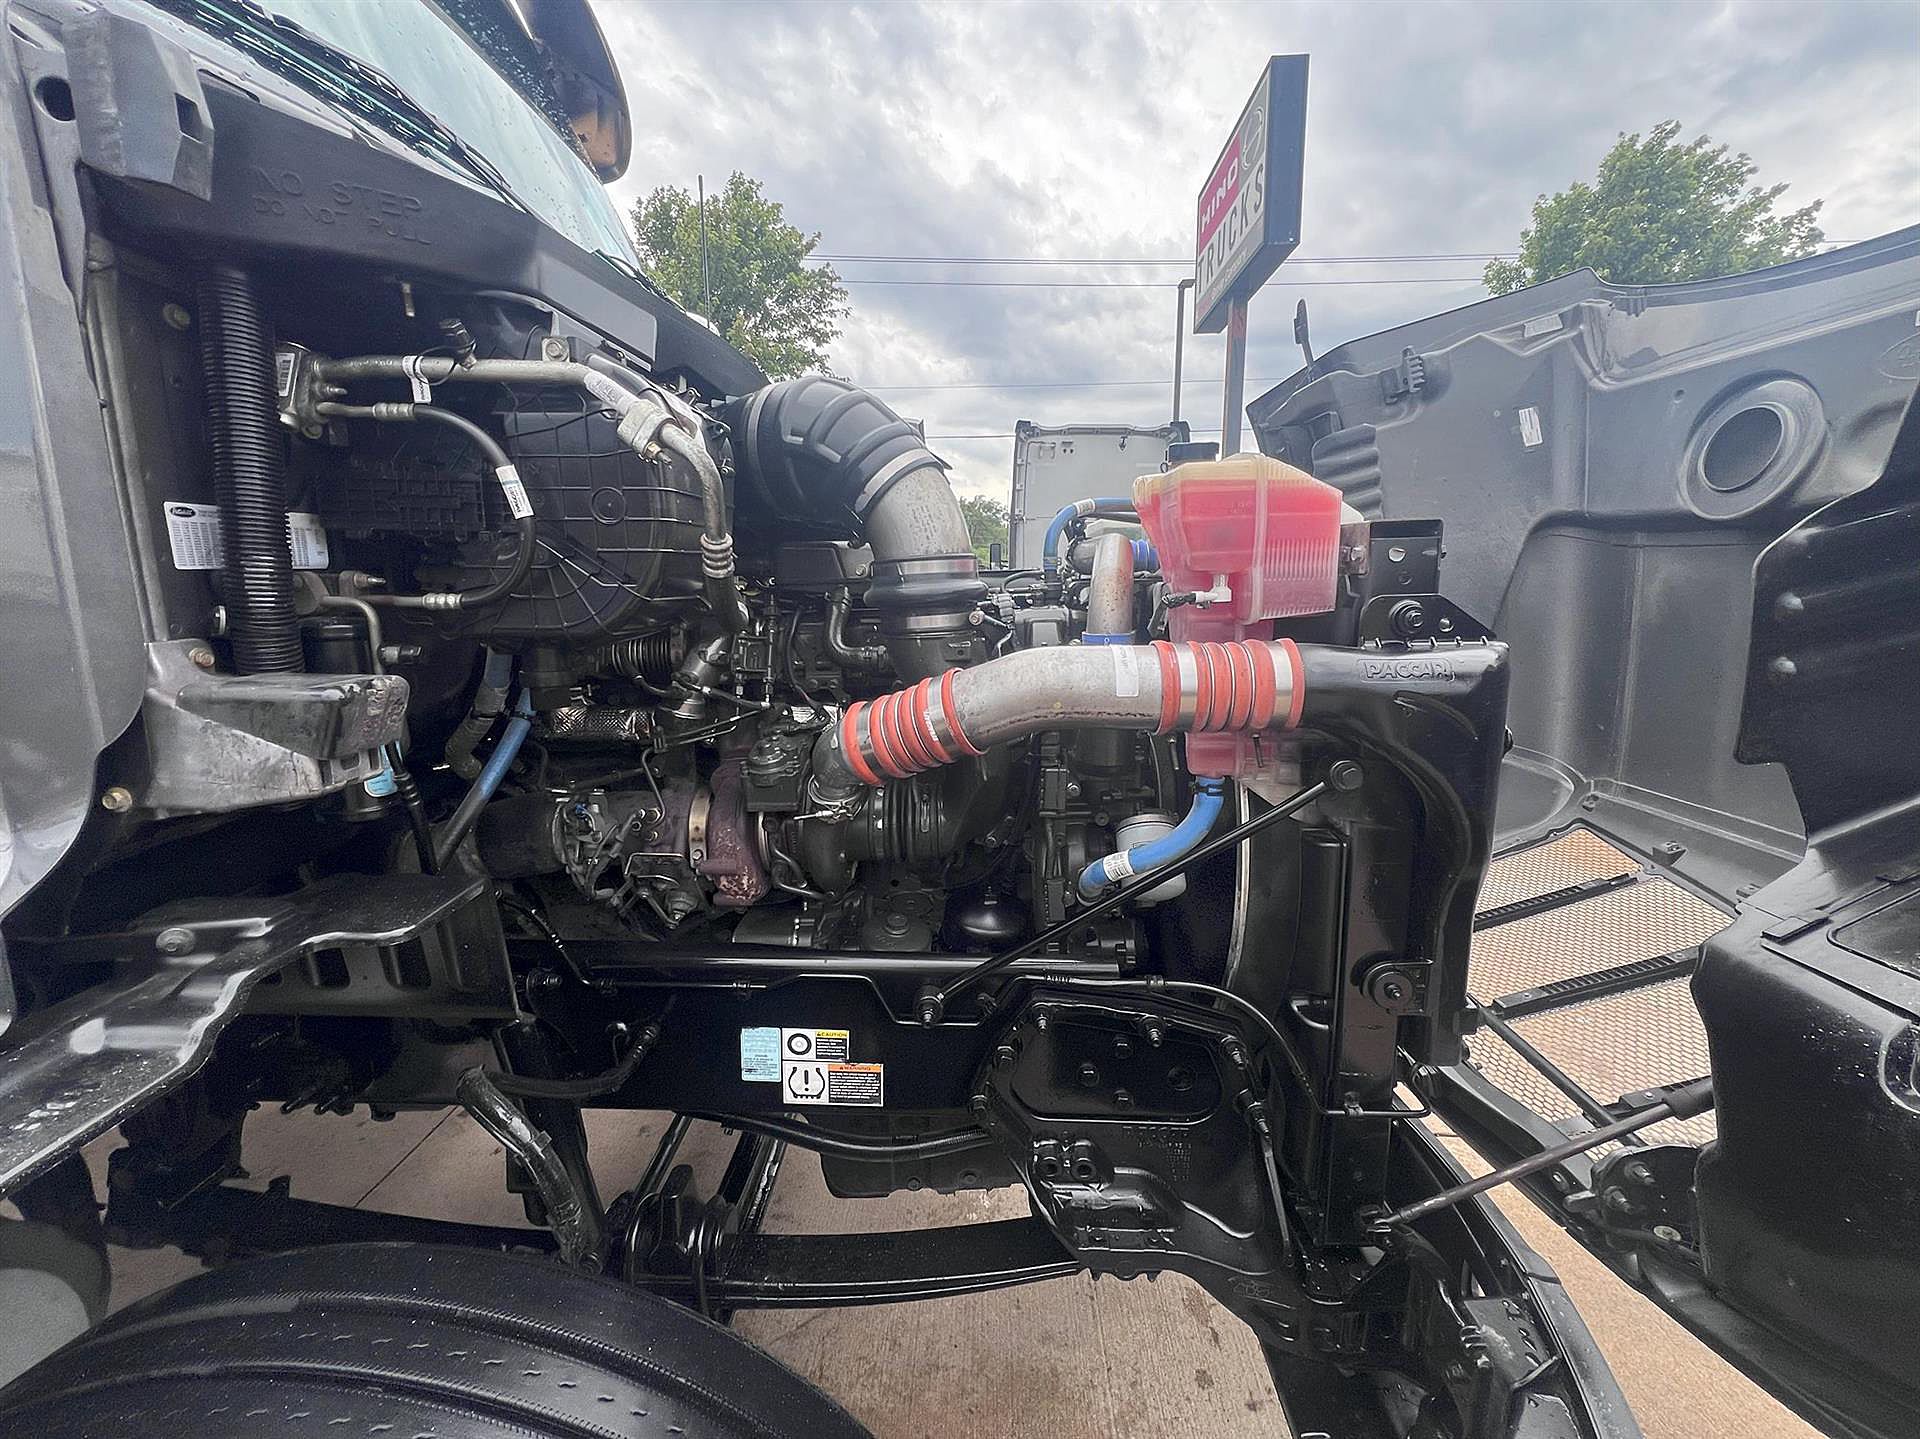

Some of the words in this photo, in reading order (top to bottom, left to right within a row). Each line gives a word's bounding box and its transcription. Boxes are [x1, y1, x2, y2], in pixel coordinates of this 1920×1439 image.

[250, 165, 303, 196] NO
[326, 180, 423, 217] STEP
[252, 194, 288, 217] DO
[1201, 157, 1238, 233] HINO
[1198, 163, 1263, 294] TRUCKS
[1364, 661, 1451, 680] PACCAR
